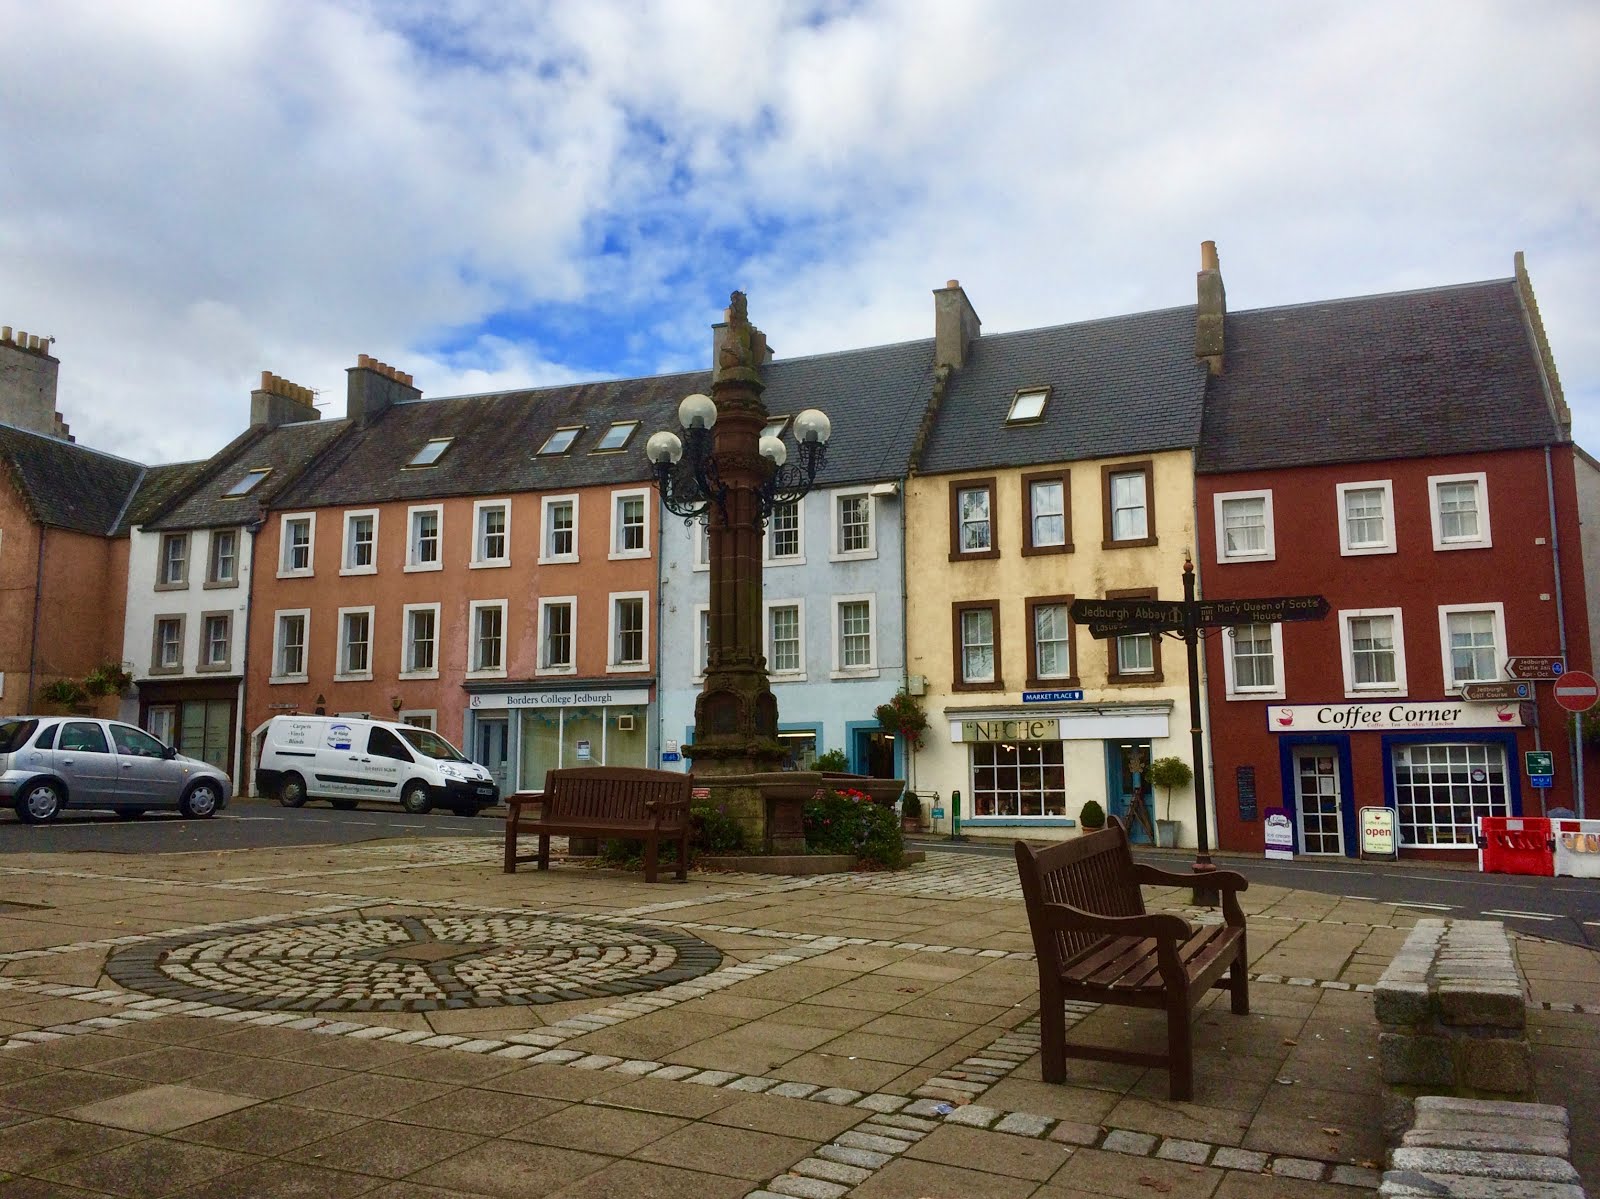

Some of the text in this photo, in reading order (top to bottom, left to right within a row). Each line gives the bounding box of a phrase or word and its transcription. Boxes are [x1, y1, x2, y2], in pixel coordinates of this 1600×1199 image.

[1082, 606, 1129, 621] Jedburgh
[1217, 603, 1240, 614] Mary
[1243, 602, 1272, 611] Queen
[1275, 600, 1286, 609] of
[1253, 612, 1282, 620] House
[507, 693, 612, 705] Borders College Jedburgh
[1317, 705, 1462, 729] Coffee Corner
[1366, 828, 1392, 837] open
